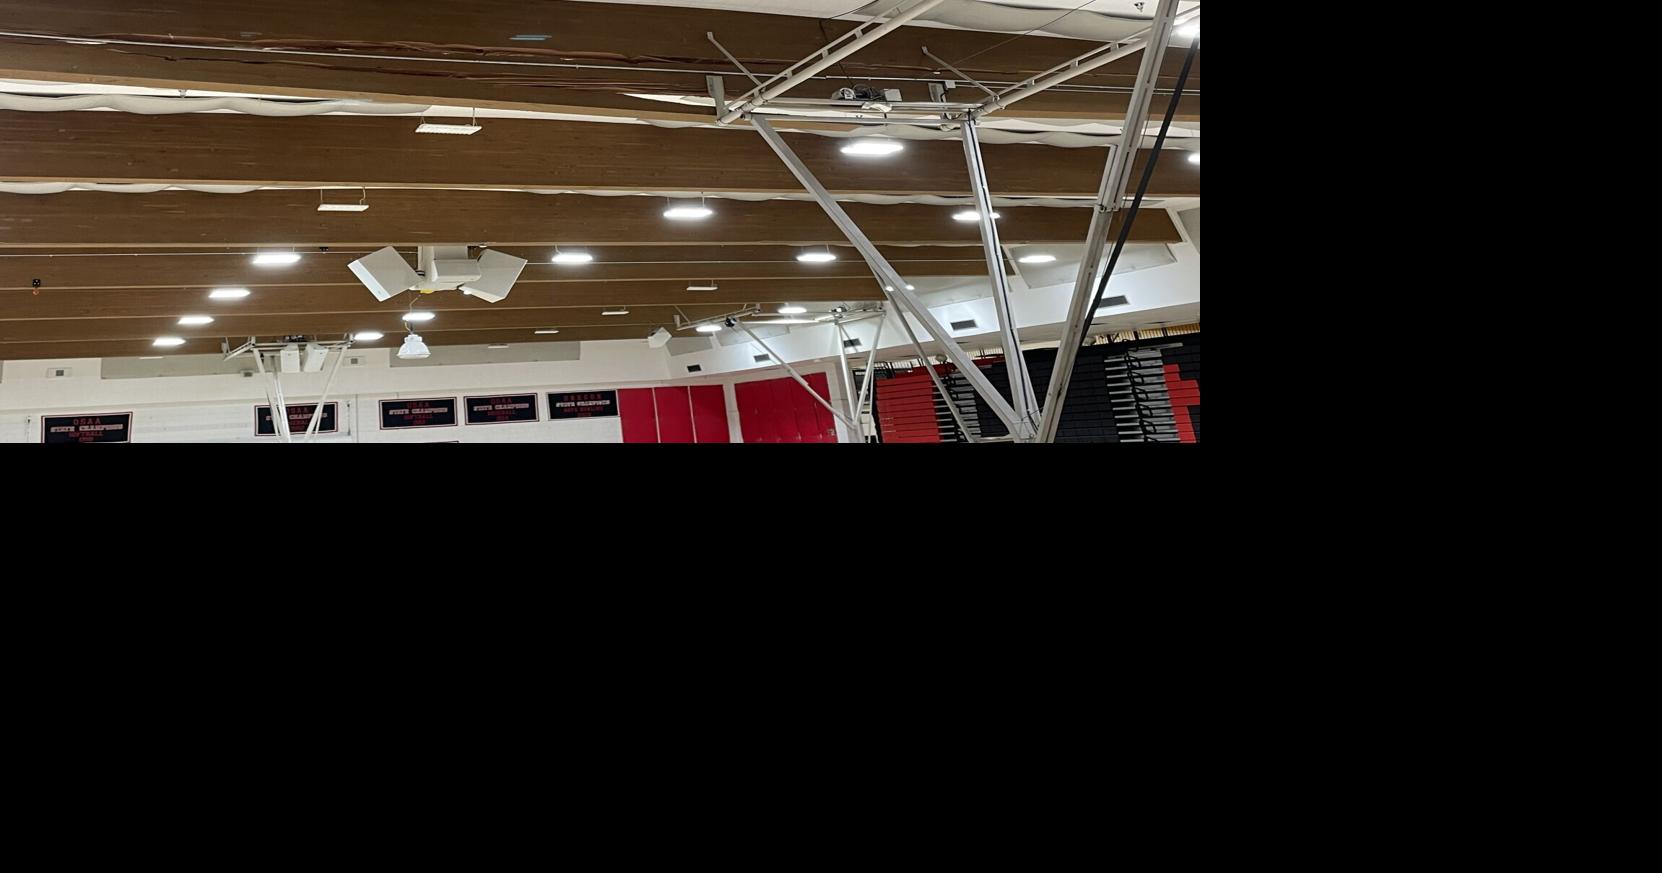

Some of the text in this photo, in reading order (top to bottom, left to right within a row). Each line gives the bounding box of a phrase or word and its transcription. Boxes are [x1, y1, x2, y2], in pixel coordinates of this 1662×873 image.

[73, 417, 101, 426] OSAA
[50, 423, 124, 433] STATE CHAMPIONS
